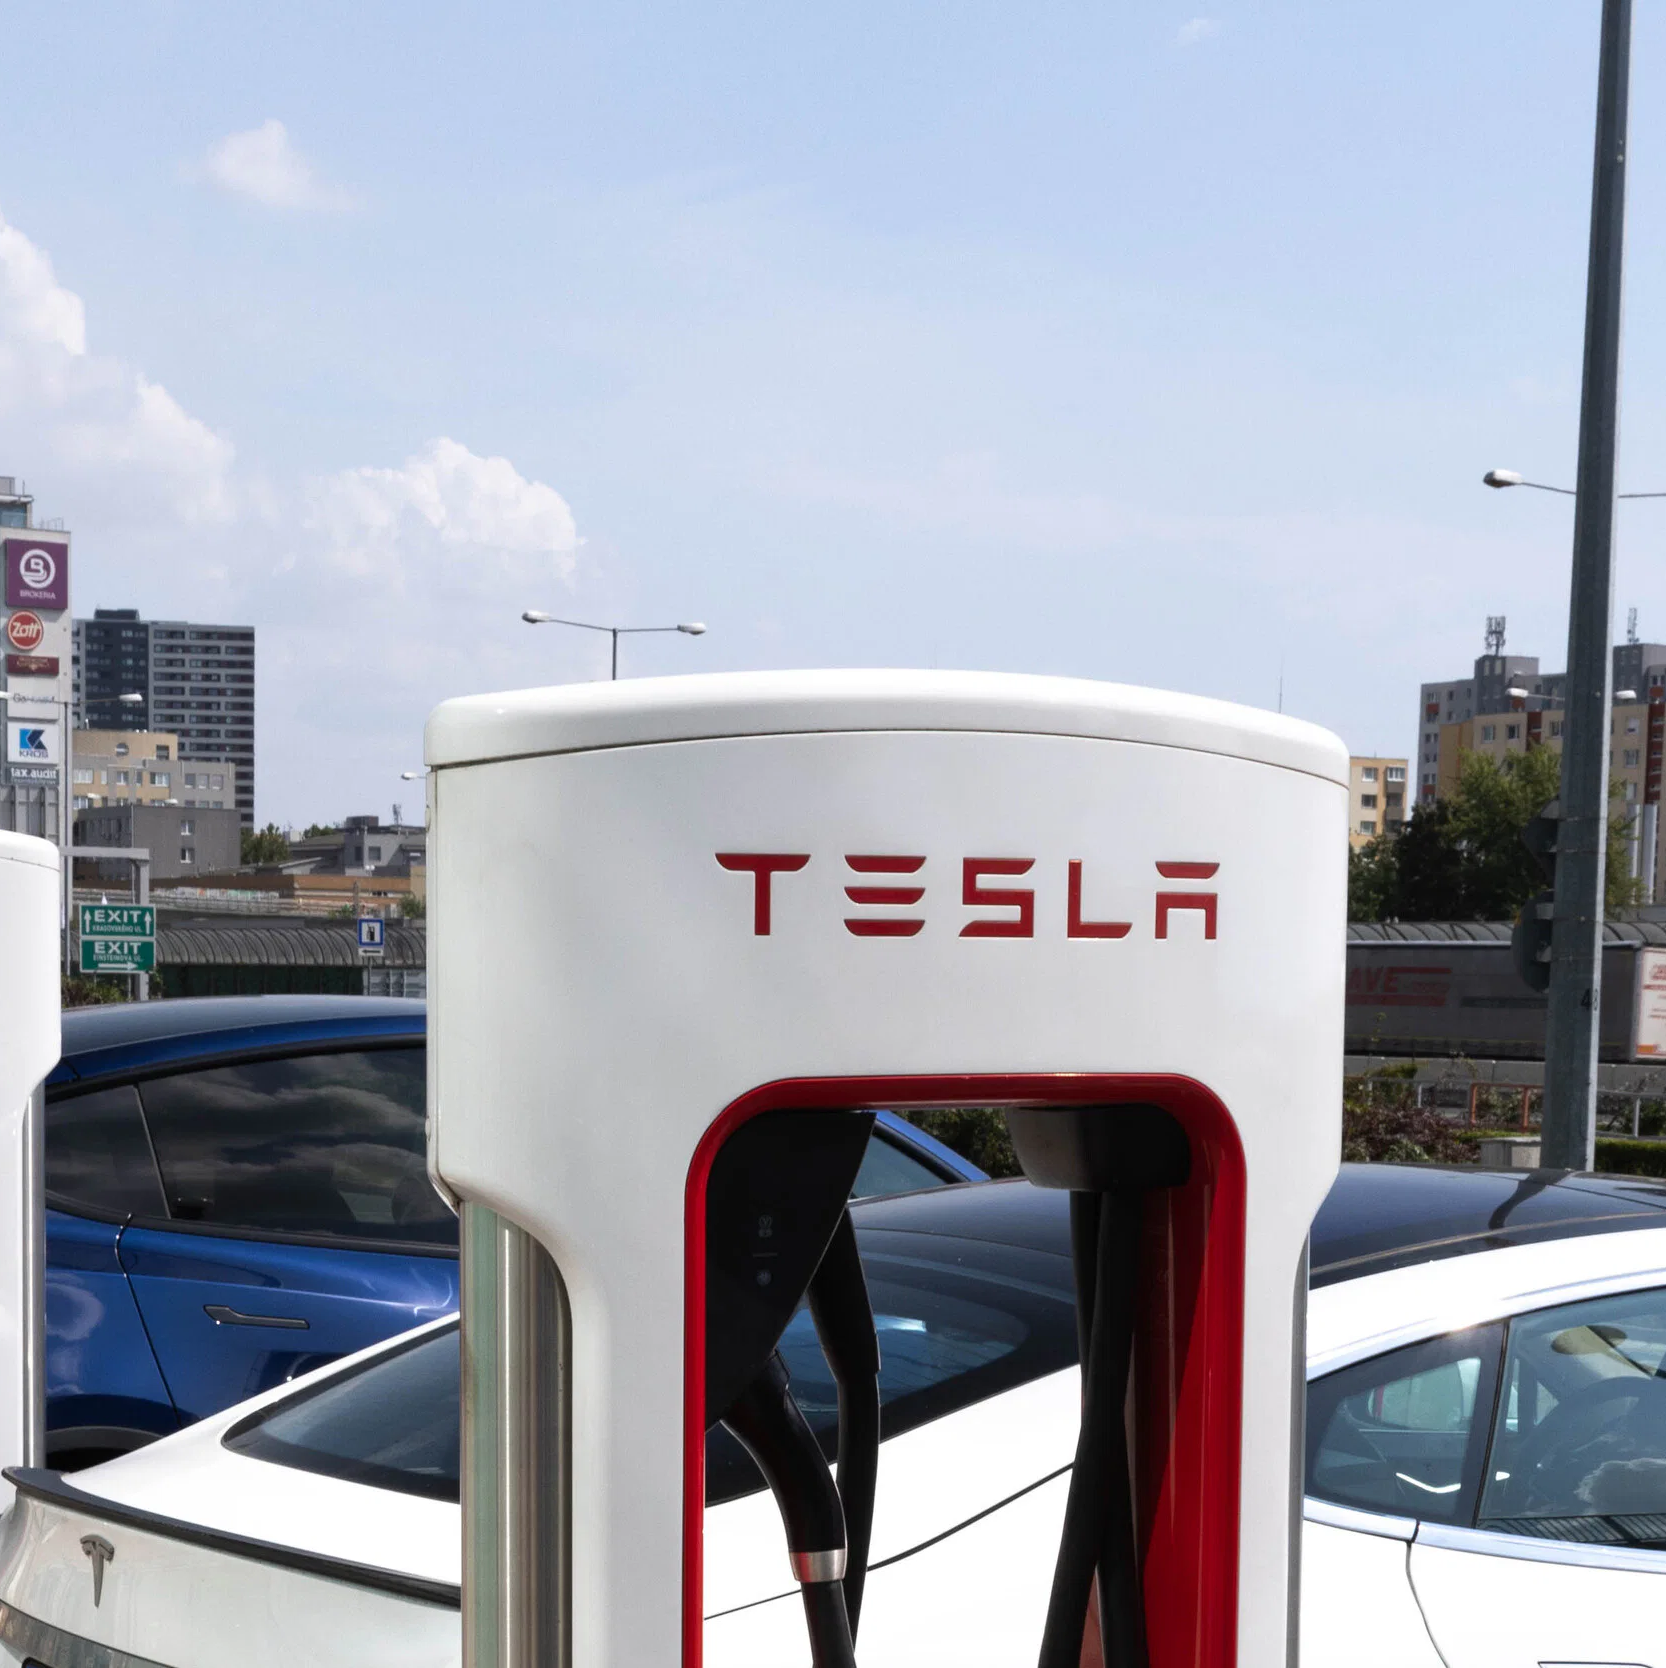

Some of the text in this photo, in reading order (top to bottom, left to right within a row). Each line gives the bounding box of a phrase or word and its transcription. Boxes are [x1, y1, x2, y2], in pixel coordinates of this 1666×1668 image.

[19, 589, 56, 599] BROKERIA
[12, 621, 41, 639] Zott
[715, 853, 1221, 940] TESLA
[94, 909, 142, 923] EXIT
[94, 941, 142, 955] EXIT
